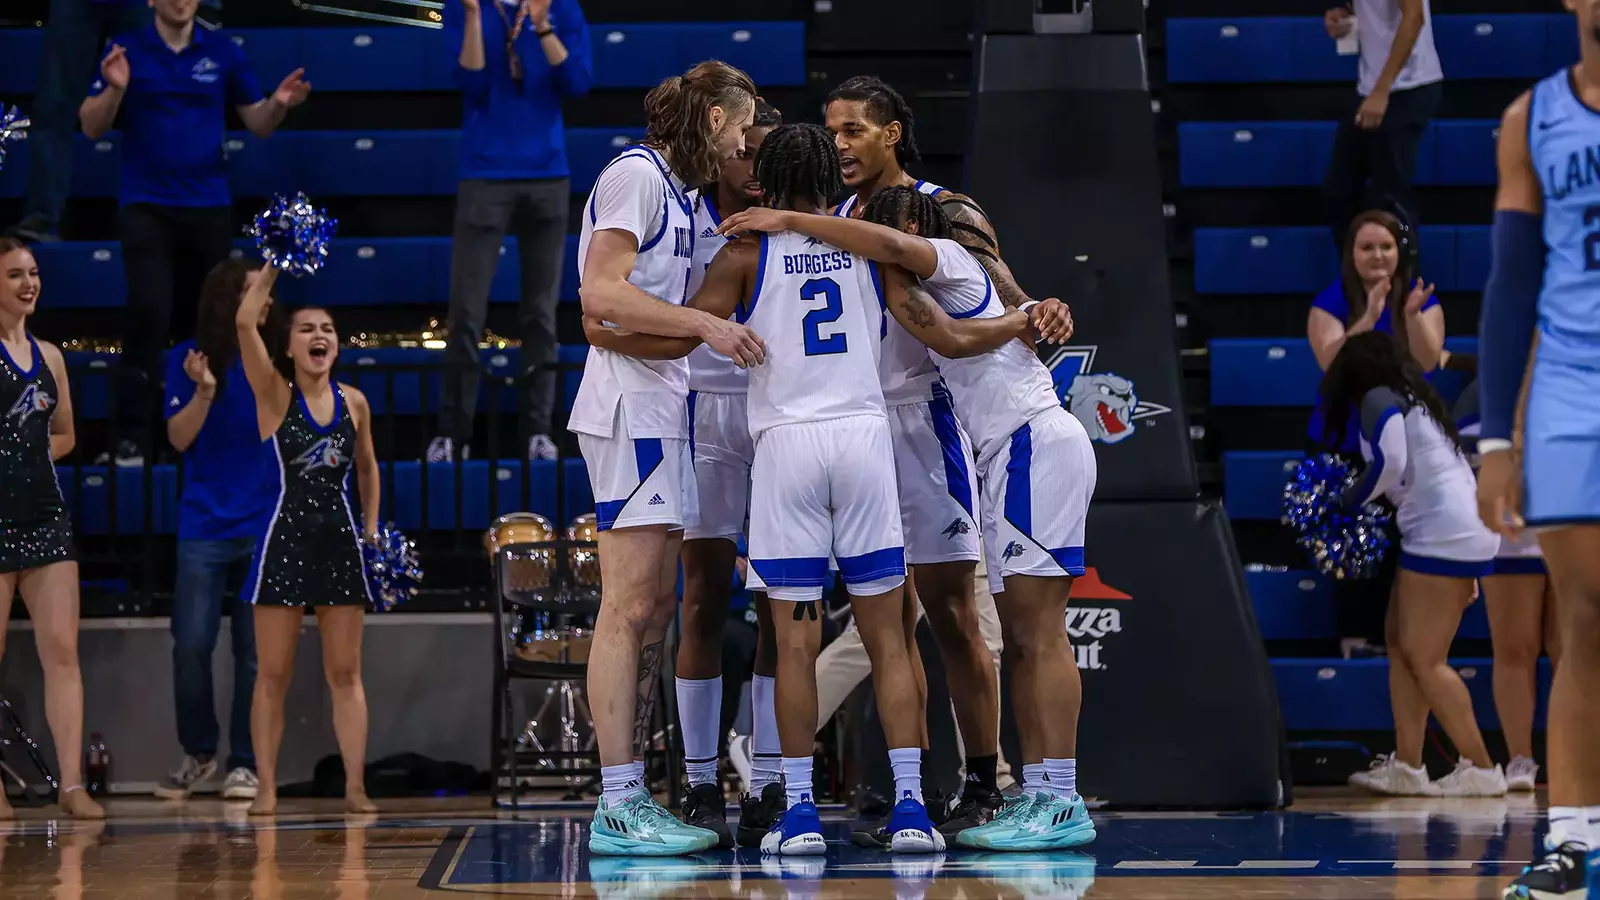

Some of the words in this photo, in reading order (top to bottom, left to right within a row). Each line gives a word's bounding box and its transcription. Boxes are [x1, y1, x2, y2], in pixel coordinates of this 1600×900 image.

[783, 250, 853, 275] BURGESS
[799, 276, 848, 356] 2
[1065, 607, 1122, 638] zza
[1071, 640, 1103, 670] ut
